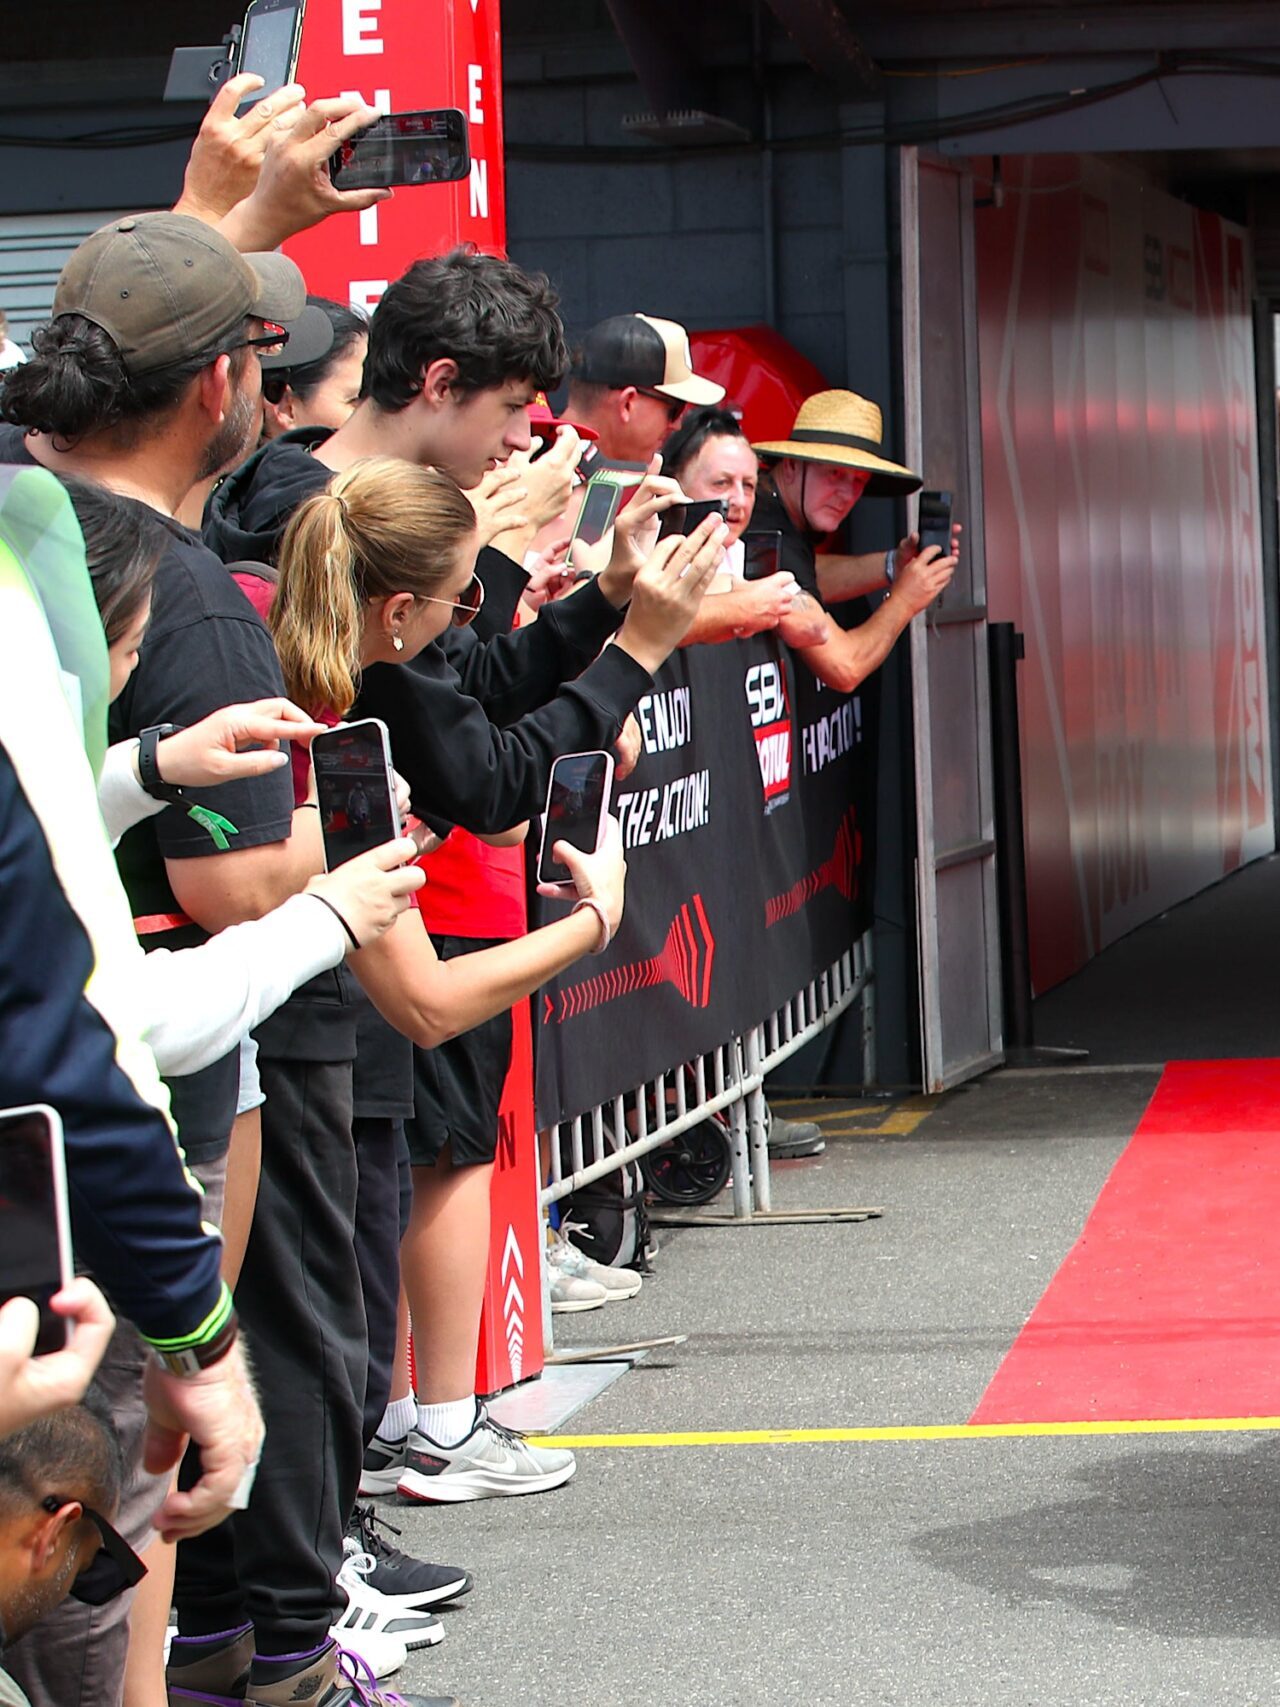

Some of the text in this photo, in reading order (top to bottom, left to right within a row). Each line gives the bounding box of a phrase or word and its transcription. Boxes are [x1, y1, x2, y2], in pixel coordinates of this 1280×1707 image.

[638, 686, 691, 754] ENJOY
[617, 769, 710, 849] THE ACTION!
